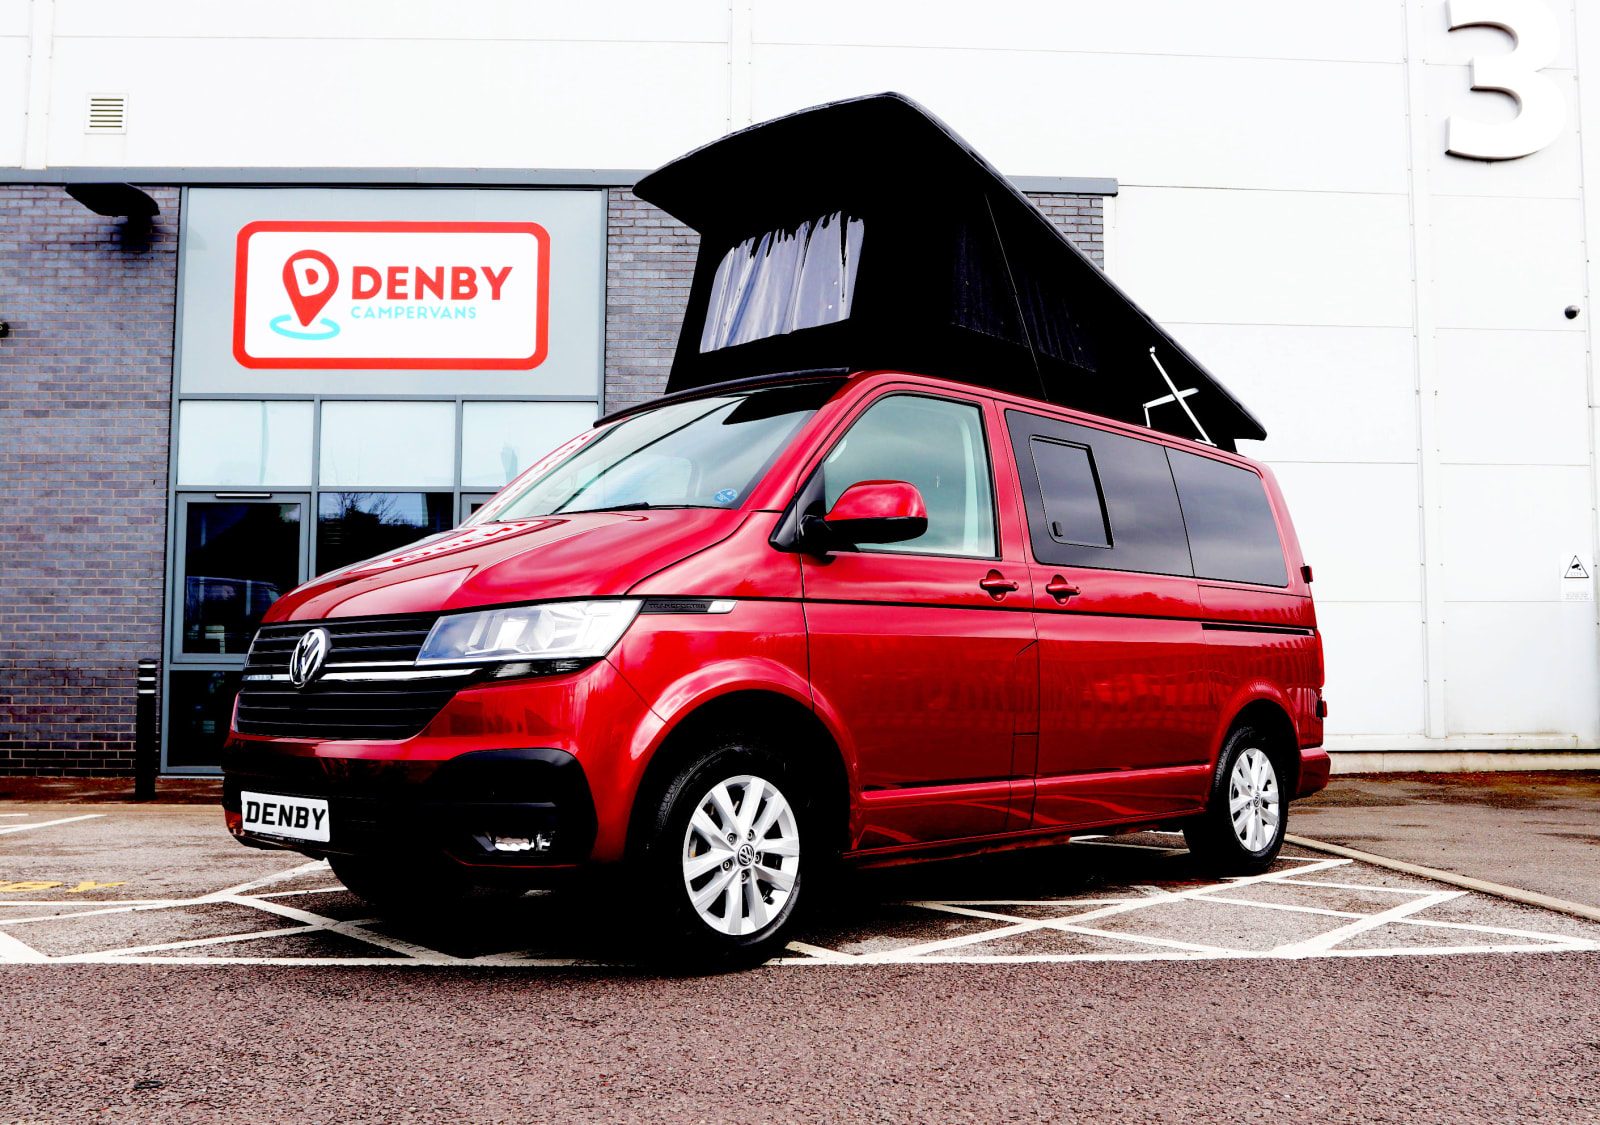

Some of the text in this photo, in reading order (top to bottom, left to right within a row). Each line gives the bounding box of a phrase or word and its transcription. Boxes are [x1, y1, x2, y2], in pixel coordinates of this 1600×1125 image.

[1444, 0, 1567, 162] 3
[351, 265, 513, 301] DENBY
[350, 305, 477, 319] CAMPERVANS
[244, 800, 327, 831] DENBY
